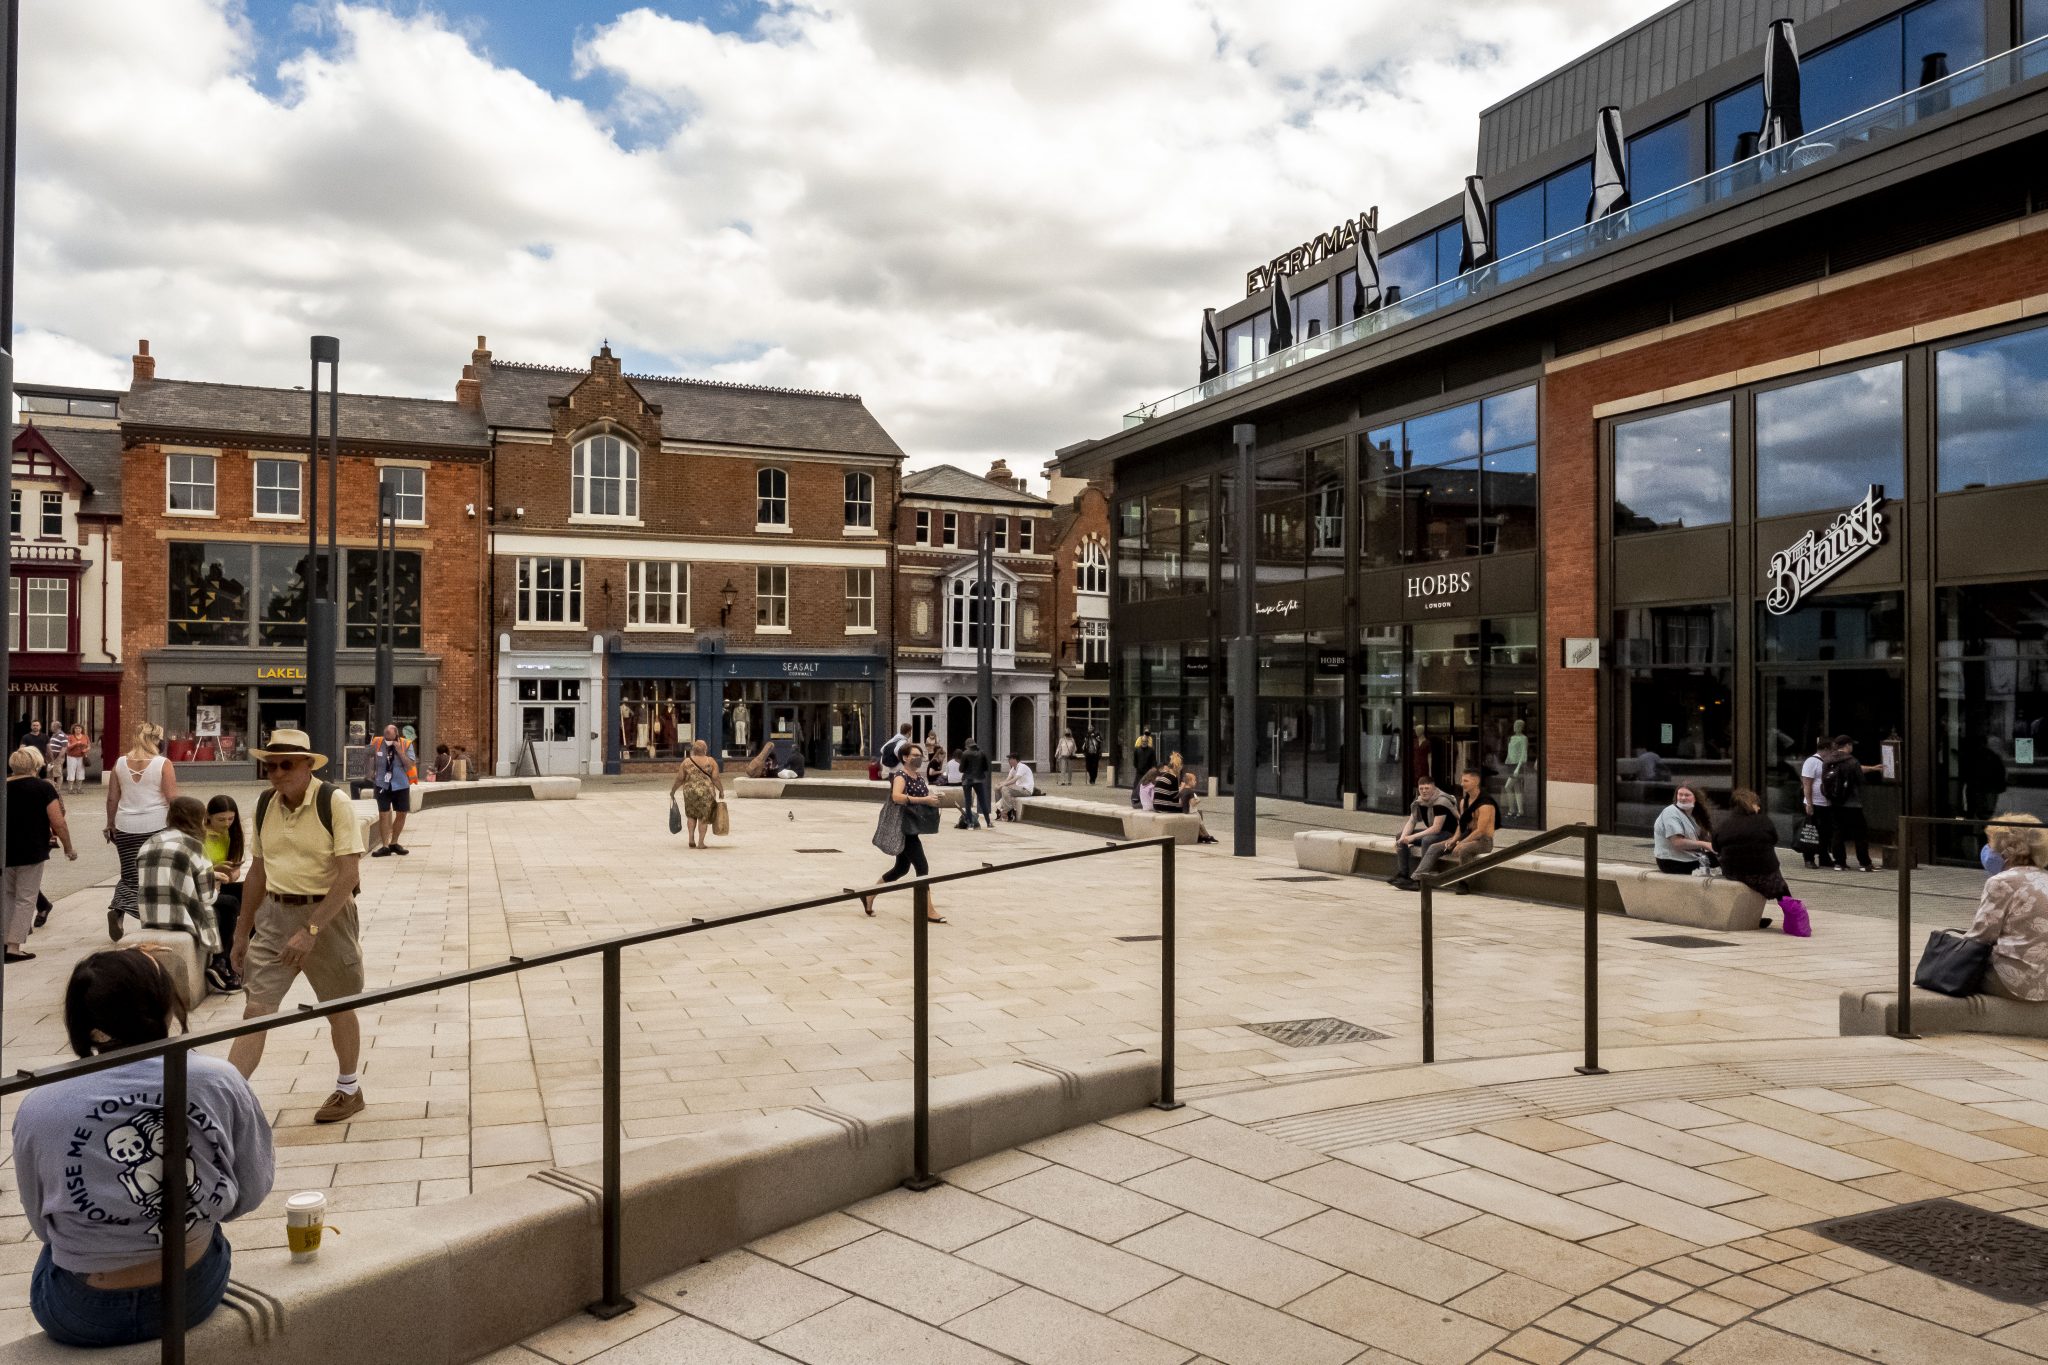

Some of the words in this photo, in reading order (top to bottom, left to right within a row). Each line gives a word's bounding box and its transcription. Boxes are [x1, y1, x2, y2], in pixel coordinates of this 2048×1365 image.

[1247, 206, 1378, 297] EVERYMAN
[1766, 484, 1882, 615] Botanist
[1408, 571, 1470, 597] HOBBS
[1255, 602, 1275, 614] hase
[1275, 599, 1298, 616] Eight
[1424, 601, 1451, 609] LONDON
[782, 662, 820, 671] SEASALT
[1320, 656, 1345, 664] HOBBS
[257, 667, 307, 678] LAKEL
[8, 682, 20, 692] R
[24, 682, 59, 692] PARK
[67, 1126, 93, 1158] ME
[187, 1101, 218, 1132] TAY
